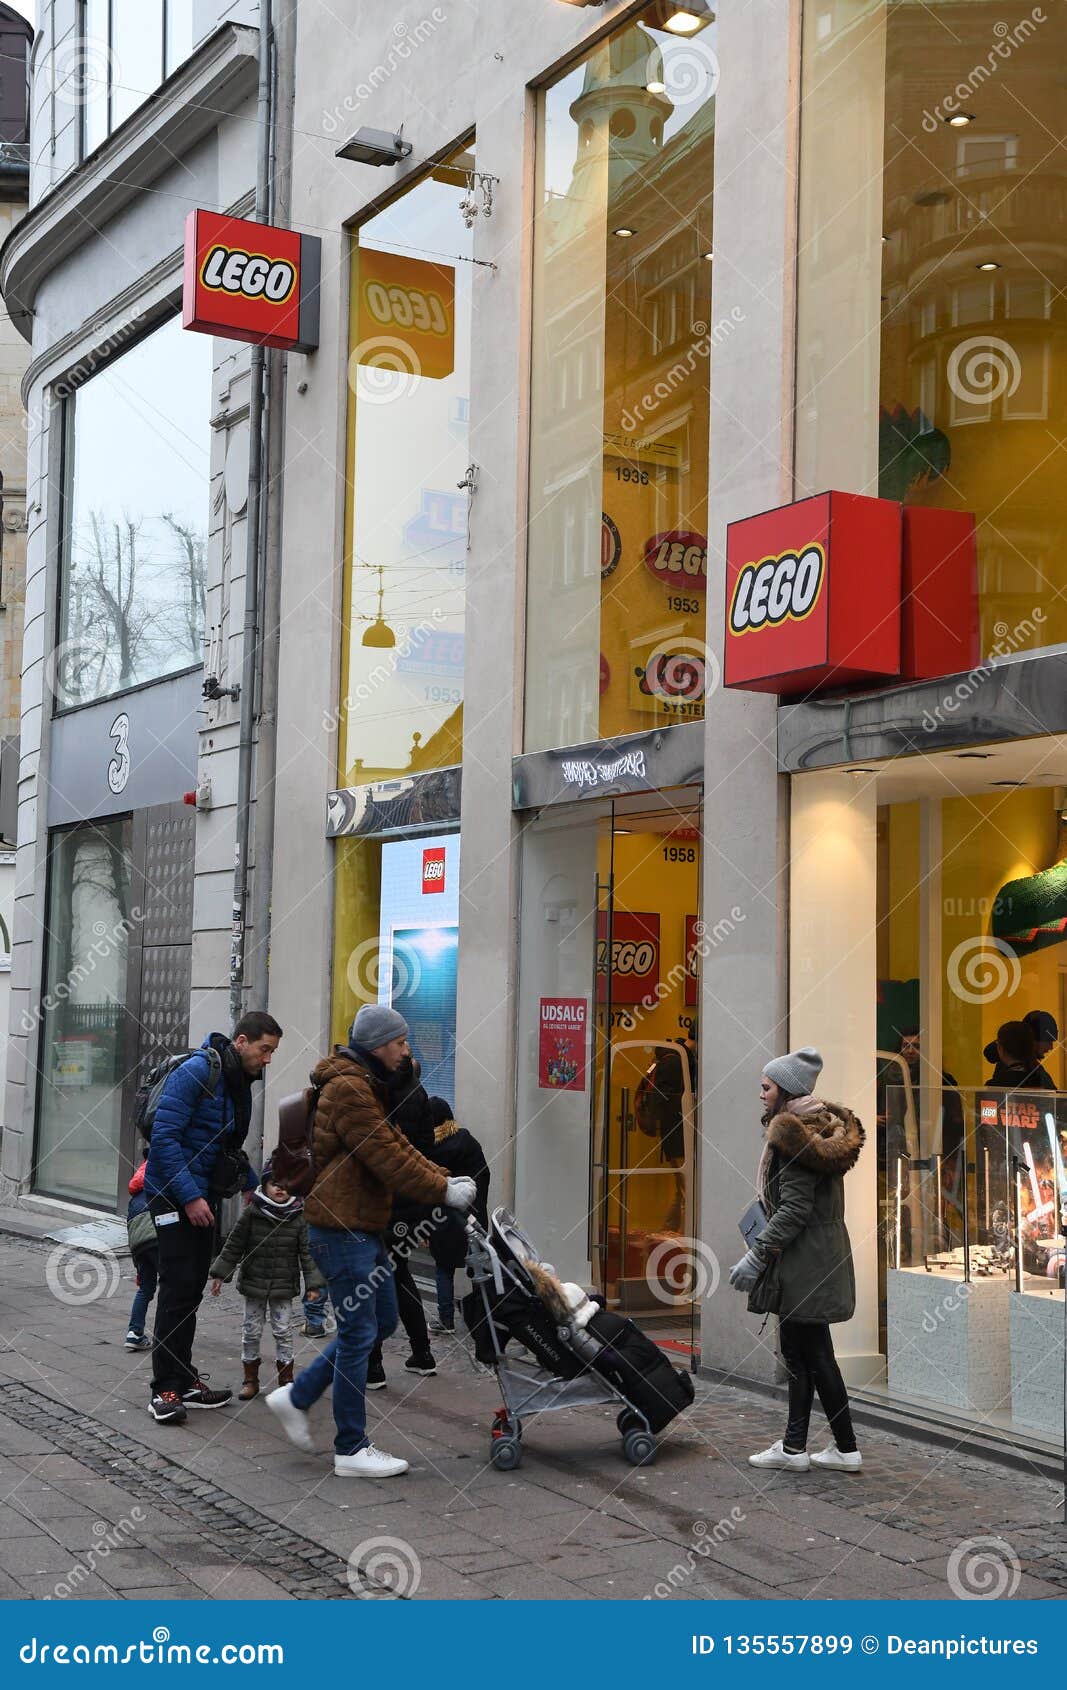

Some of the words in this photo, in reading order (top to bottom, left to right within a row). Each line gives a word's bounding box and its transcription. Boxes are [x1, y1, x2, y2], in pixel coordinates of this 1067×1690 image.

[202, 247, 295, 302] LEGO
[730, 546, 823, 632] LEGO
[667, 597, 699, 614] 1953
[108, 712, 130, 795] 3
[662, 847, 696, 863] 1958
[424, 861, 444, 880] LEGO
[597, 941, 655, 975] LEGO
[541, 1005, 585, 1022] UDSALG
